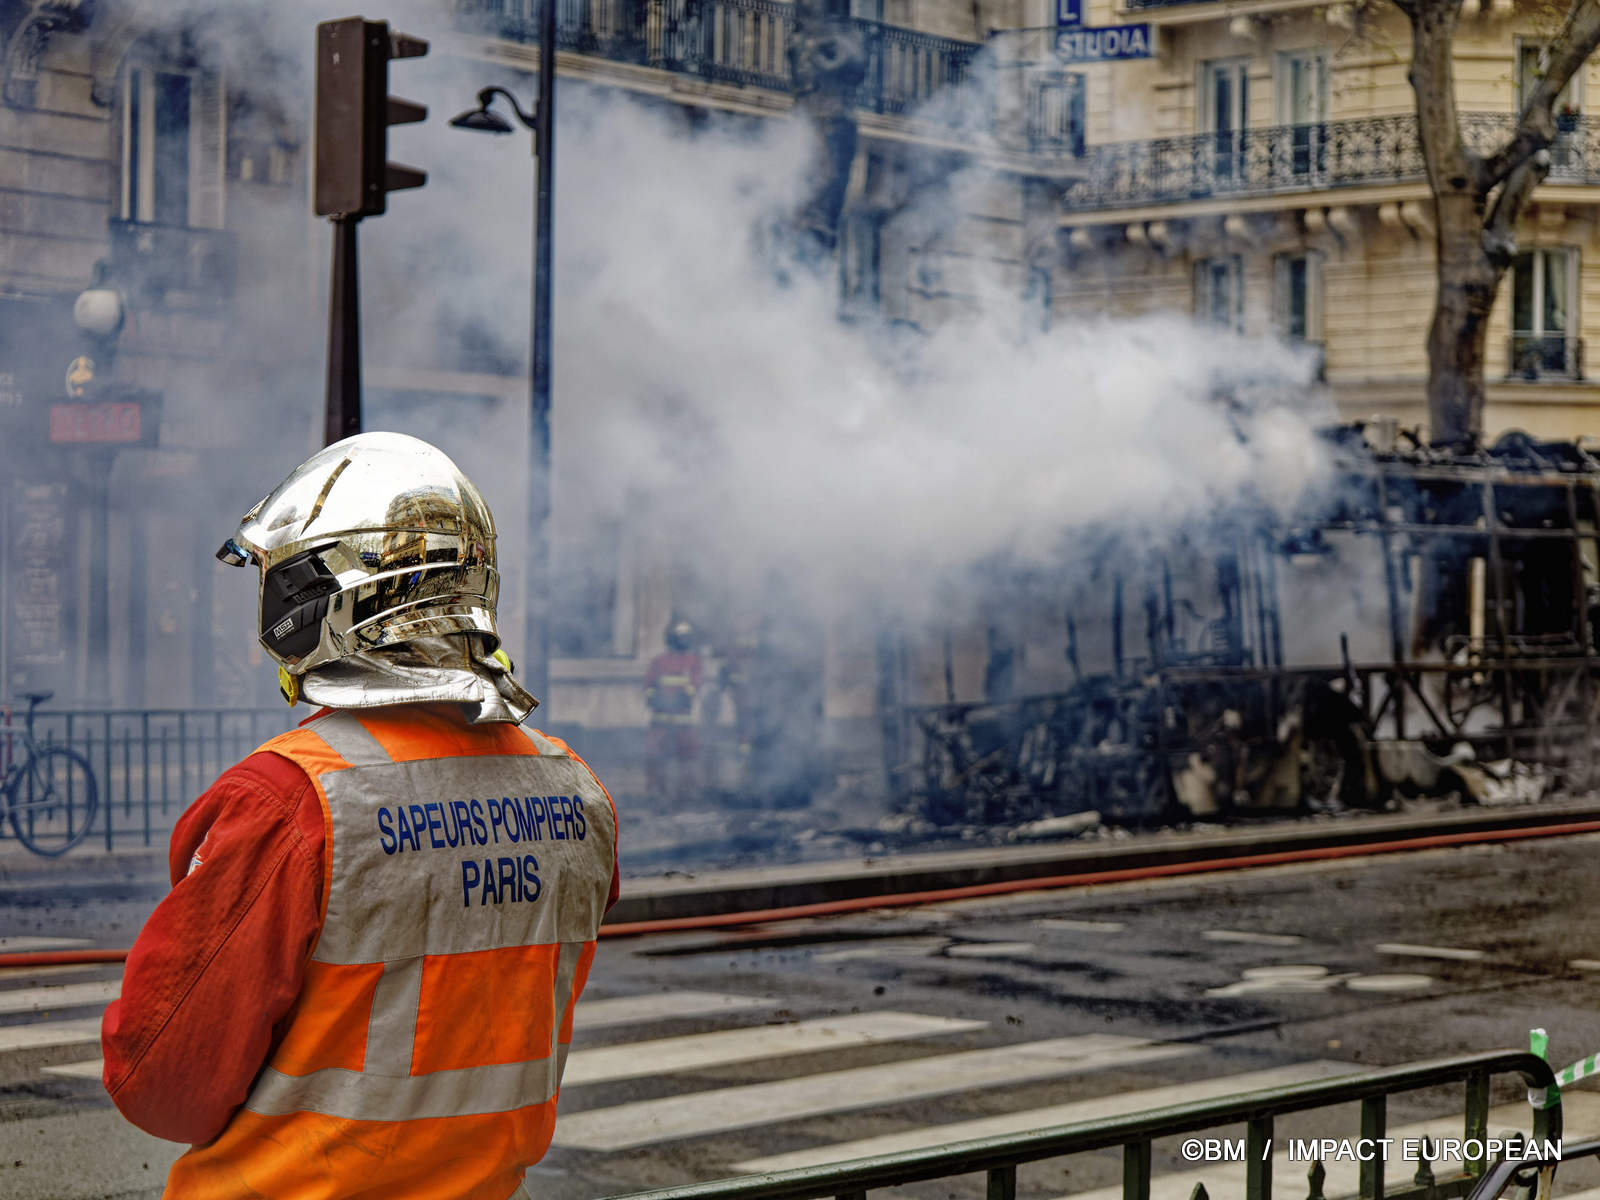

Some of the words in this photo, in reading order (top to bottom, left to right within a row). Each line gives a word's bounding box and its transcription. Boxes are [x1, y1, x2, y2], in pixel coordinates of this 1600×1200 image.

[1057, 28, 1146, 58] STUDIA
[377, 798, 488, 855] SAPEURS
[487, 794, 586, 843] POMPIERS
[461, 854, 541, 907] PARIS
